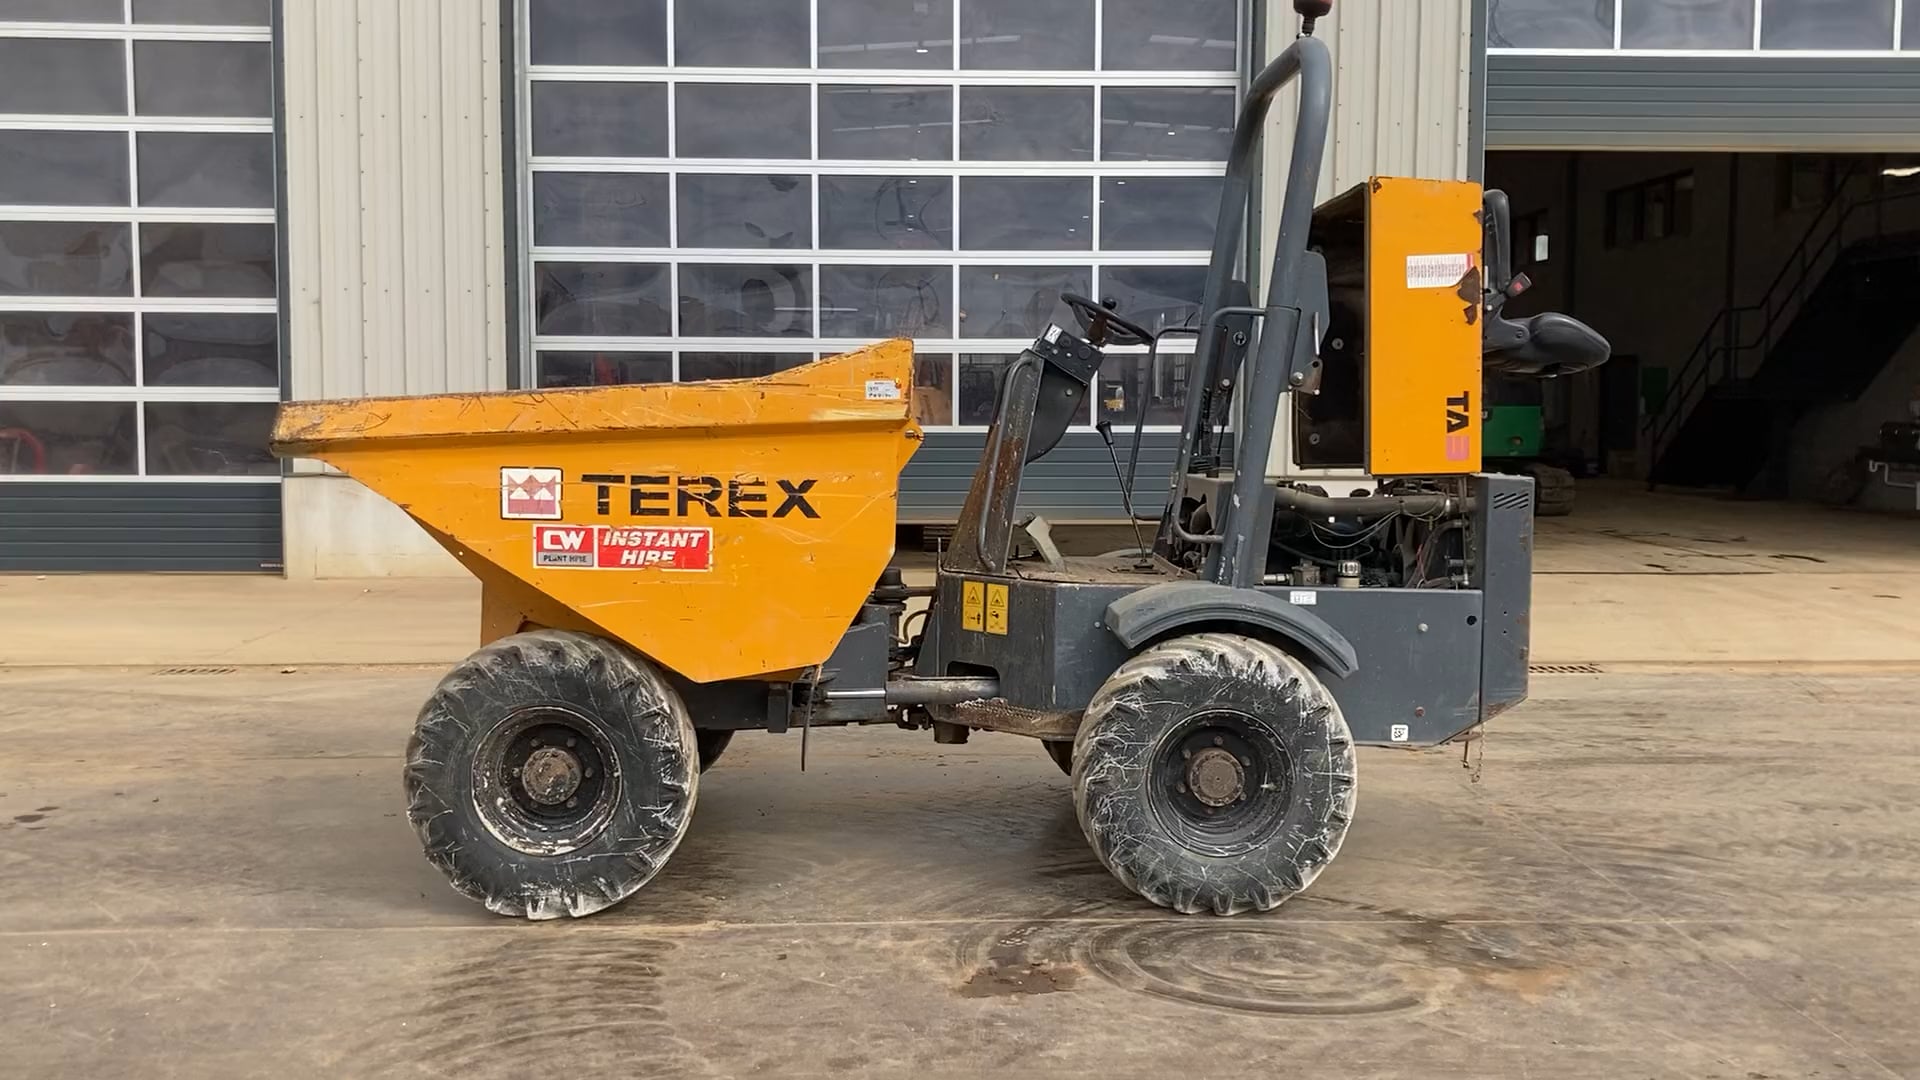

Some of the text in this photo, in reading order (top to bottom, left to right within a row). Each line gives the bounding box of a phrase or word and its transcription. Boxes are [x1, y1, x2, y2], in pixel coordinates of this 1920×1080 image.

[581, 474, 822, 518] TEREX
[543, 530, 586, 550] CW
[603, 531, 705, 548] INSTANT
[620, 550, 676, 565] HIRE
